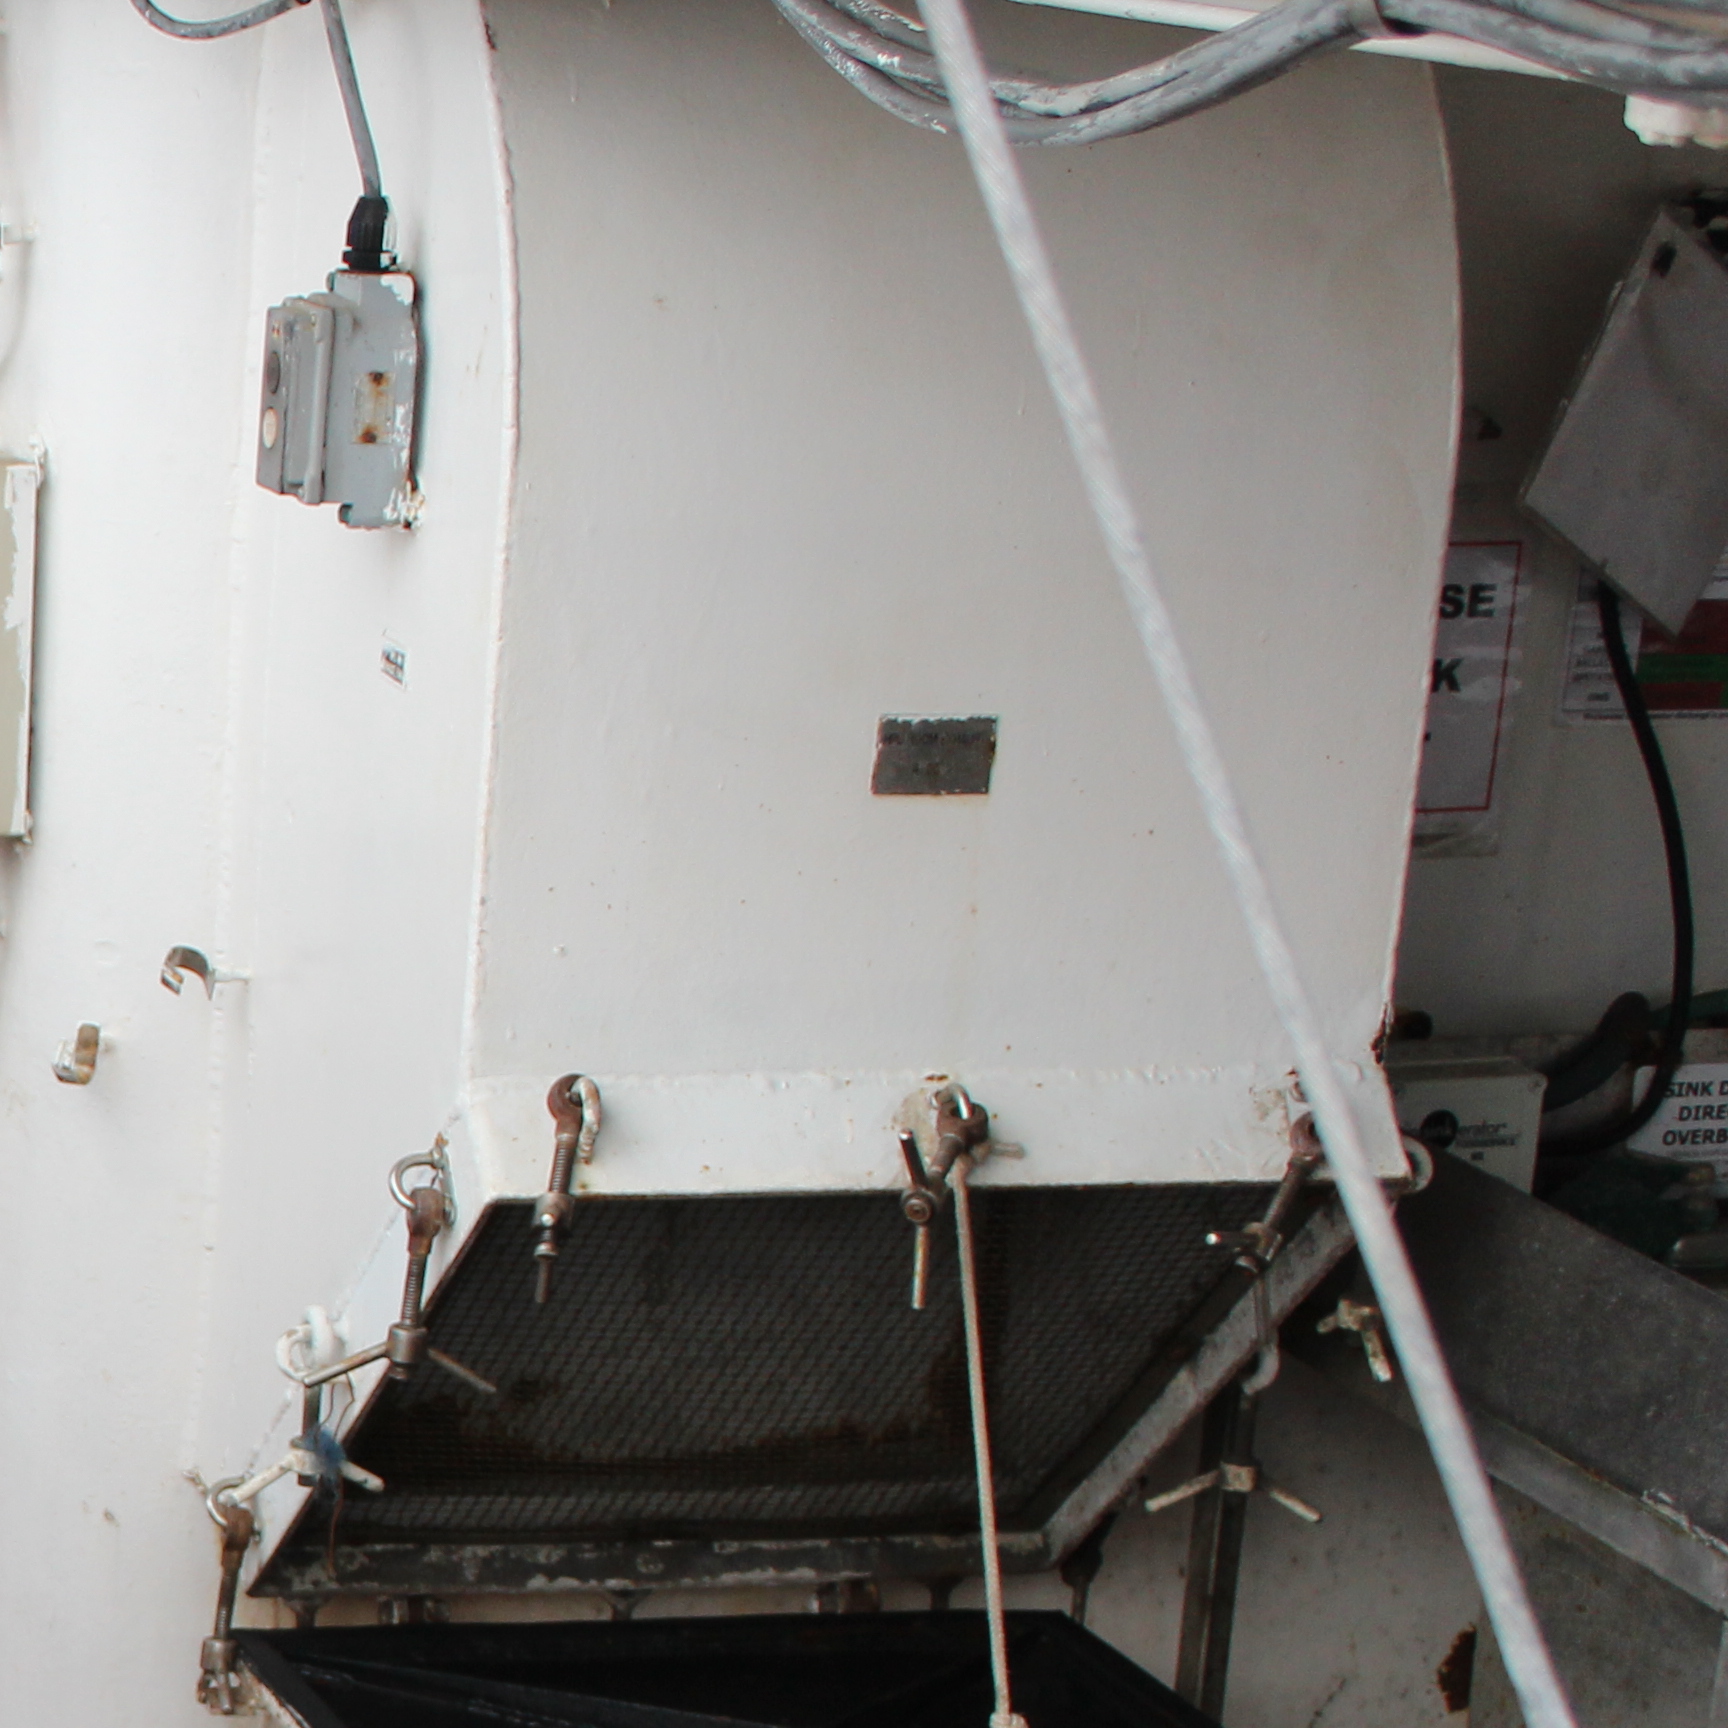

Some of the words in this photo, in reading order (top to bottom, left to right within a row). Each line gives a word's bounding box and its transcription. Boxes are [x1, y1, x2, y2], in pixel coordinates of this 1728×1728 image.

[1440, 582, 1498, 619] SE
[1678, 1105, 1728, 1121] DIRE
[1662, 1128, 1728, 1146] OVERB
